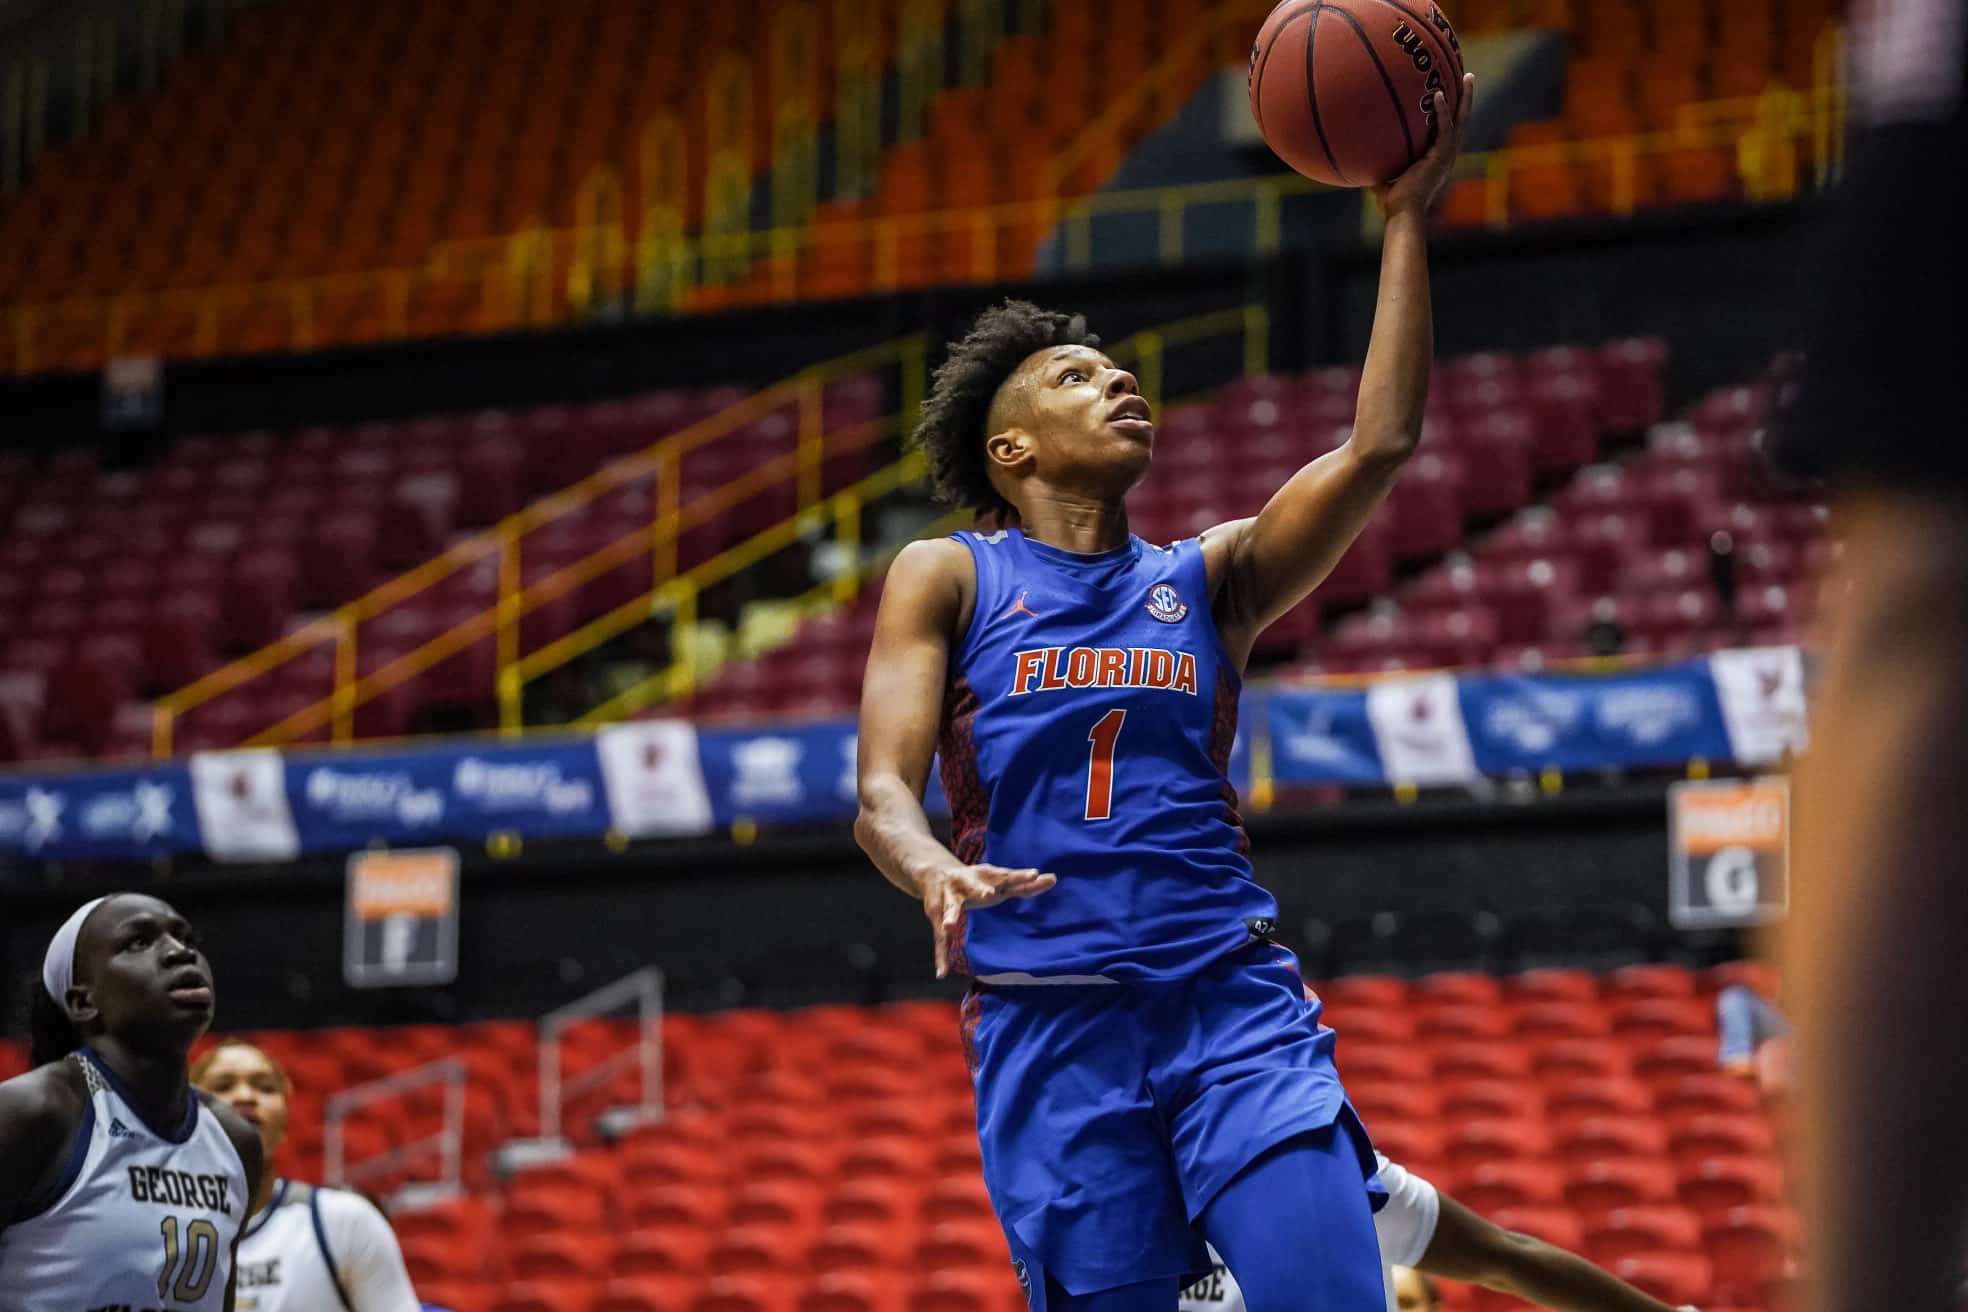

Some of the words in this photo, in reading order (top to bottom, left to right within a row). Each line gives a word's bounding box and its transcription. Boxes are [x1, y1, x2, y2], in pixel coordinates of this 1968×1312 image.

[1152, 586, 1177, 612] SEC
[1008, 646, 1197, 697] FLORIDA
[1084, 708, 1127, 821] 1
[128, 1165, 231, 1215] GEORGE
[158, 1215, 219, 1304] 10
